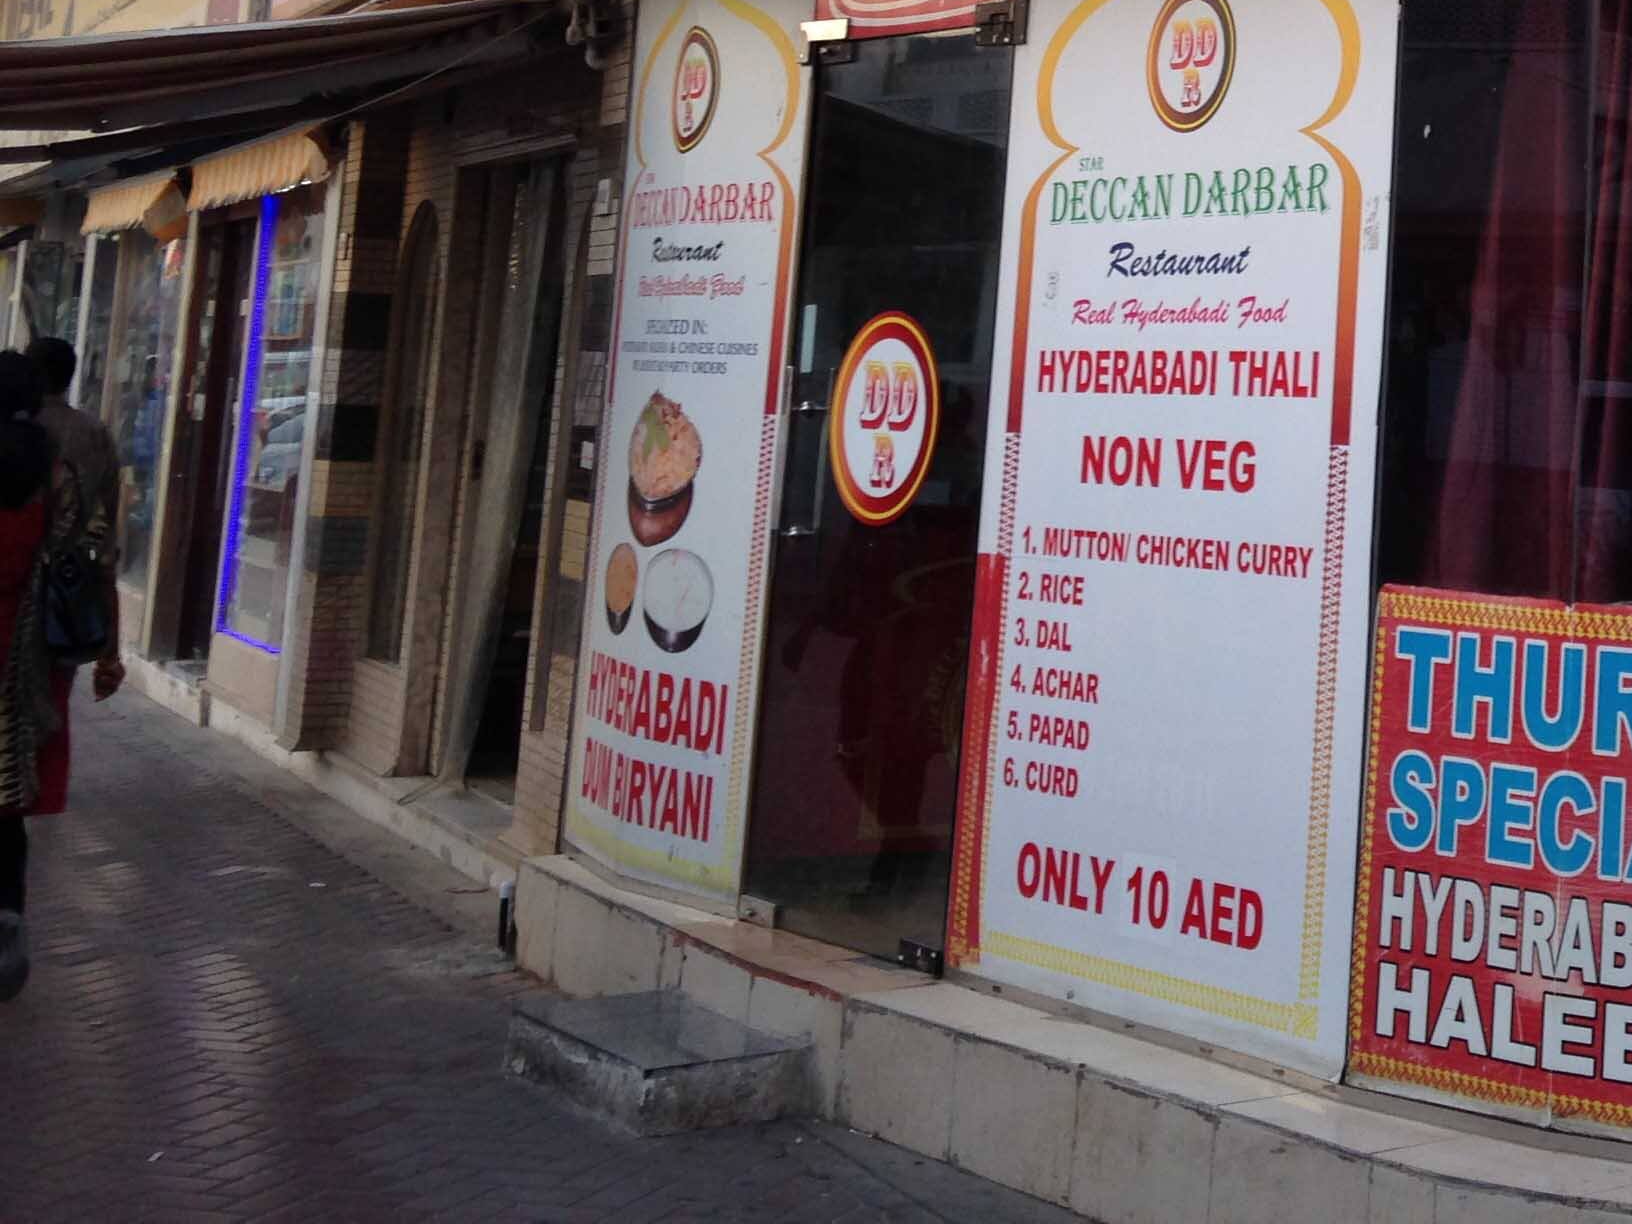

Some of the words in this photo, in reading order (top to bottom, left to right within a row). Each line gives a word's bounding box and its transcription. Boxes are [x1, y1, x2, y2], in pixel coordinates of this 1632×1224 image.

[1170, 18, 1217, 70] DD
[679, 181, 775, 224] DARBAR
[1050, 173, 1174, 225] DECCAN
[1182, 162, 1329, 219] DARBAR
[1107, 241, 1251, 278] Restaurant
[1071, 299, 1116, 325] Real
[1120, 297, 1231, 331] Hyderabadi
[1236, 296, 1290, 329] Food
[860, 361, 918, 431] DD
[1038, 349, 1218, 396] HYDERABADI
[1228, 351, 1320, 398] THALI
[870, 433, 895, 488] R
[1080, 435, 1162, 488] NON
[1176, 439, 1257, 494] VEG
[1022, 526, 1037, 555] 1.
[1136, 534, 1230, 572] CHICKEN
[1237, 542, 1314, 579] CURRY
[1017, 571, 1033, 602] 2.
[1040, 573, 1085, 606] RICE
[1014, 617, 1029, 648] 3.
[1036, 619, 1072, 652] DAL
[586, 651, 728, 755] HYDERABADI
[1010, 664, 1026, 694] 4.
[1031, 667, 1099, 704] ACHAR
[1007, 710, 1022, 741] 5.
[1028, 713, 1090, 751] PAPAD
[582, 737, 613, 810] DUM
[612, 752, 713, 843] BIRYANI
[1003, 757, 1019, 788] 6.
[1025, 761, 1079, 798] CURD
[1016, 842, 1116, 916] ONLY
[1127, 866, 1170, 930] 10
[1180, 877, 1264, 951] AED
